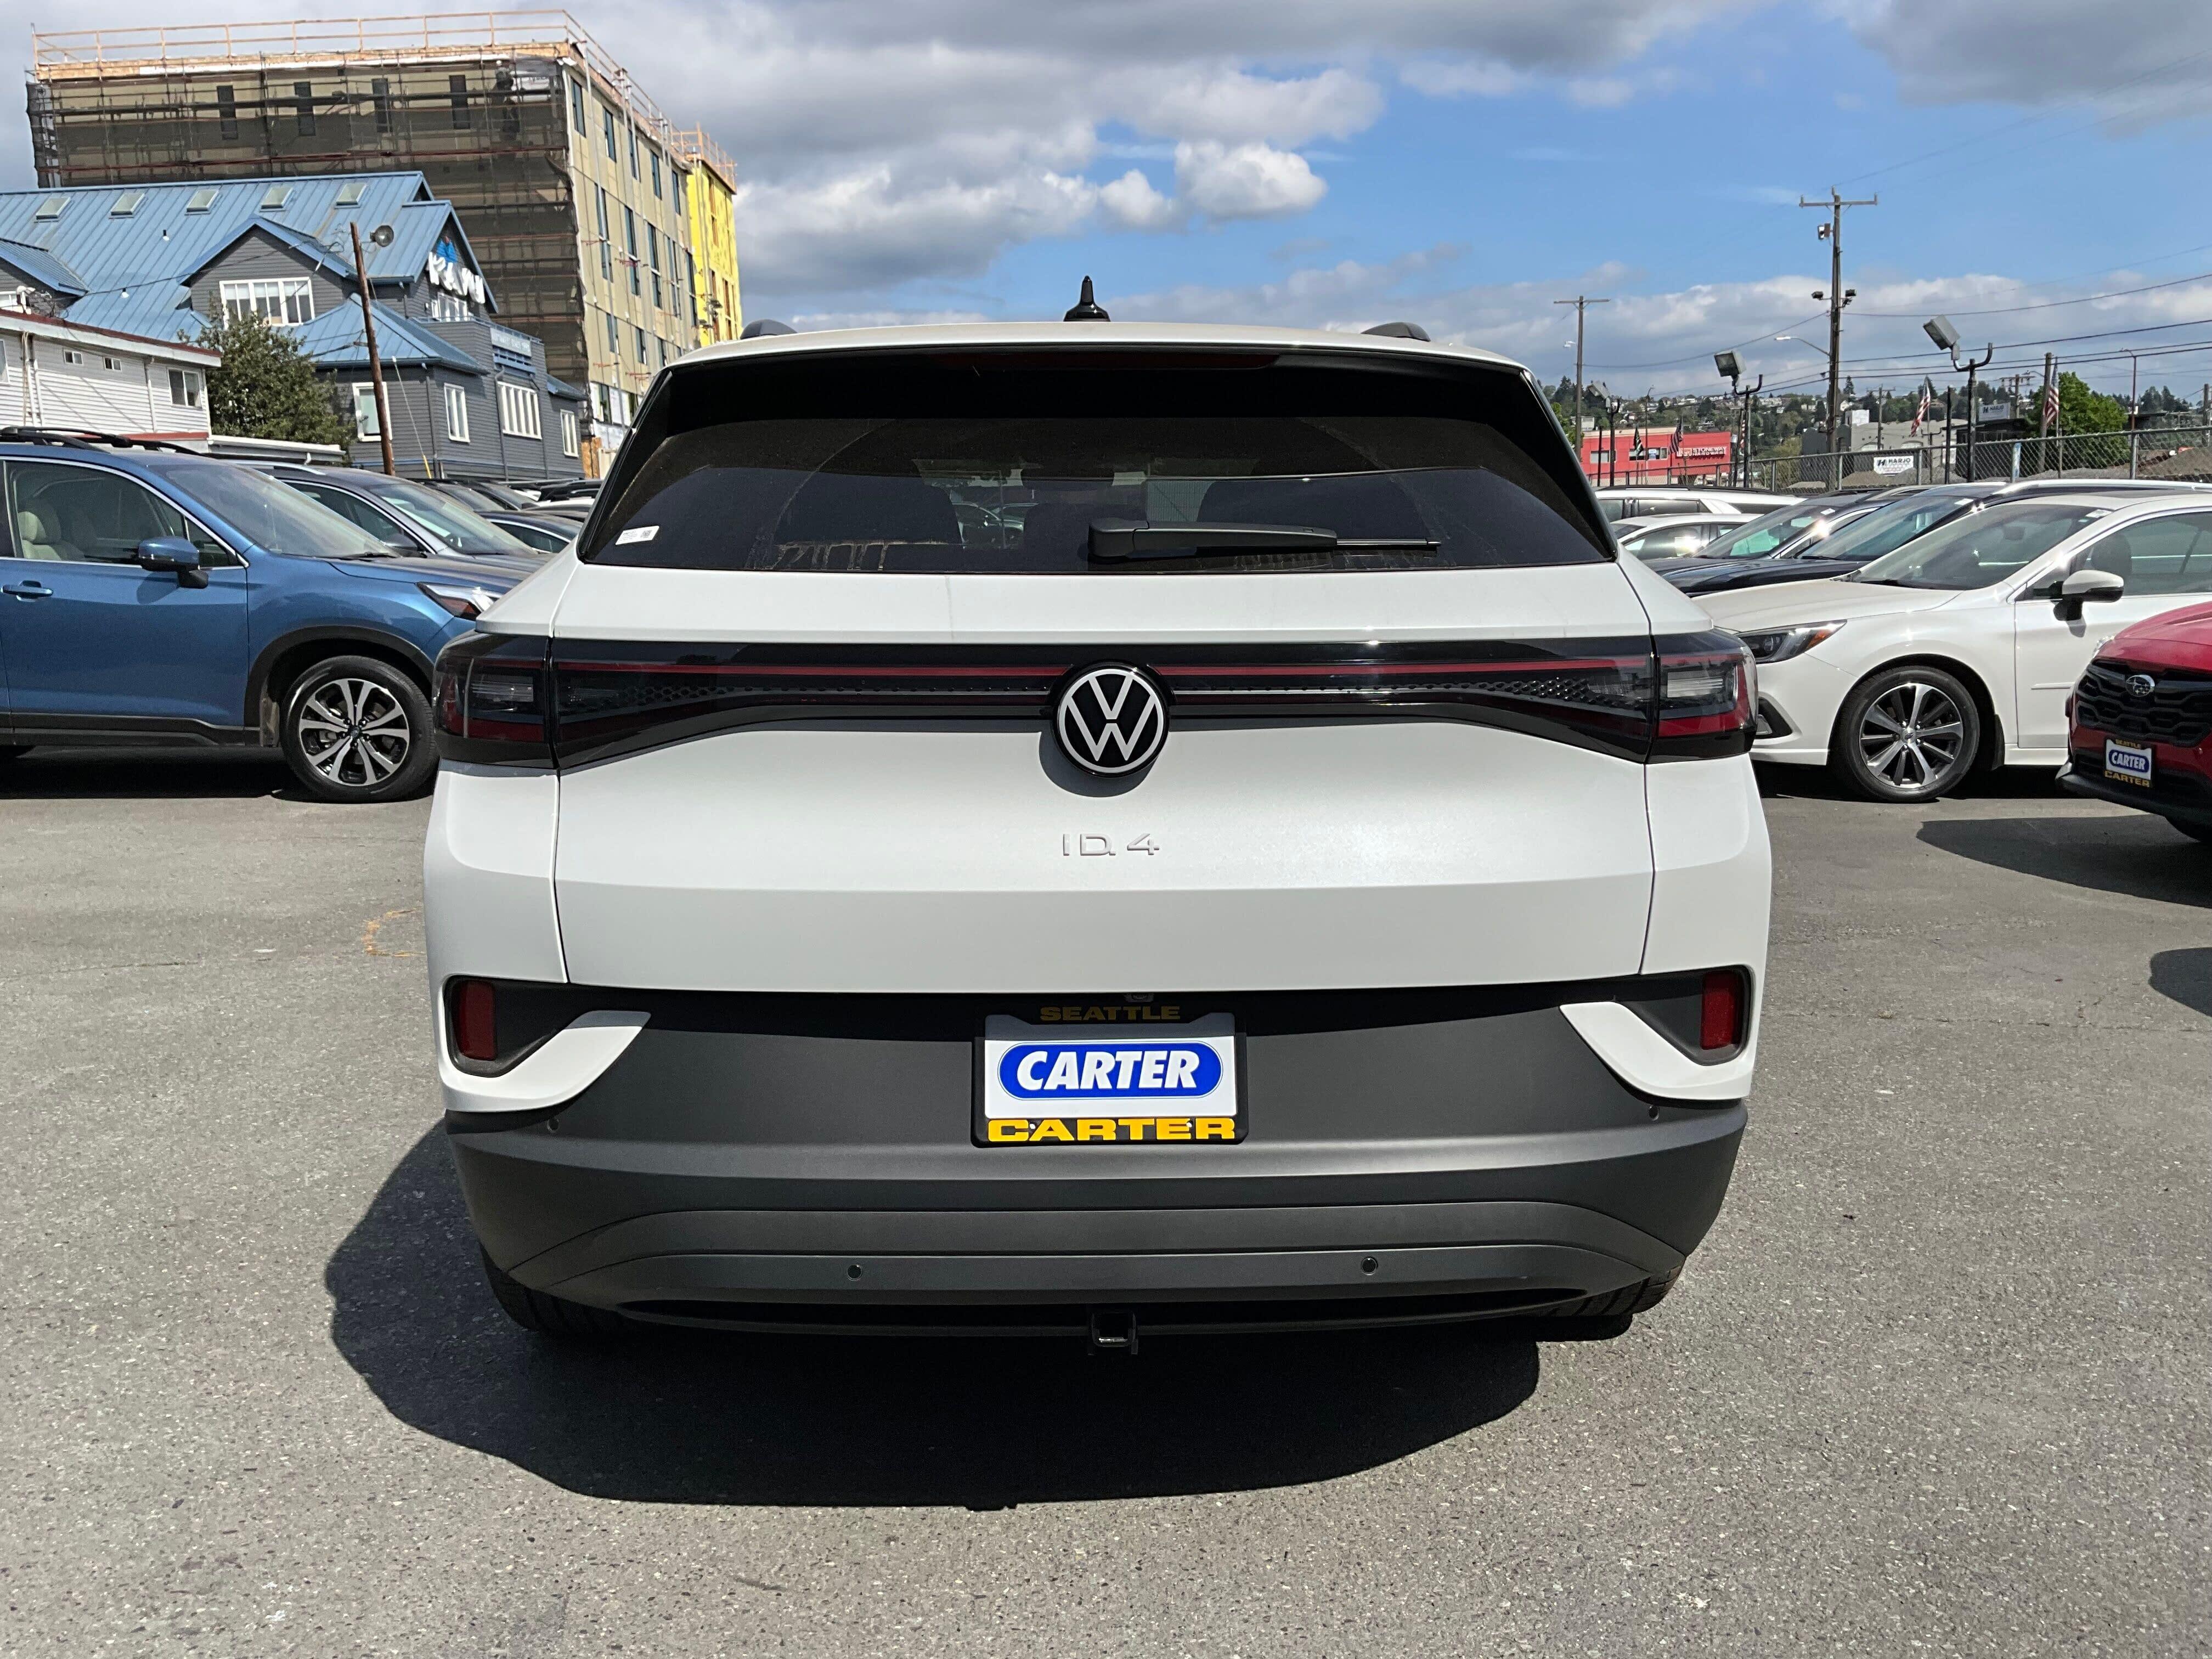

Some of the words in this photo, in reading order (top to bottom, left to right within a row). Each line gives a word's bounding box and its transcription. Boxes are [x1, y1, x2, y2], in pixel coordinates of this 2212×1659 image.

[2111, 752, 2146, 770] CARTER
[2104, 770, 2150, 788] CARTER
[1039, 1005, 1181, 1022] SEATTLE
[1016, 1049, 1200, 1091] CARTER
[988, 1117, 1235, 1142] CARTER
